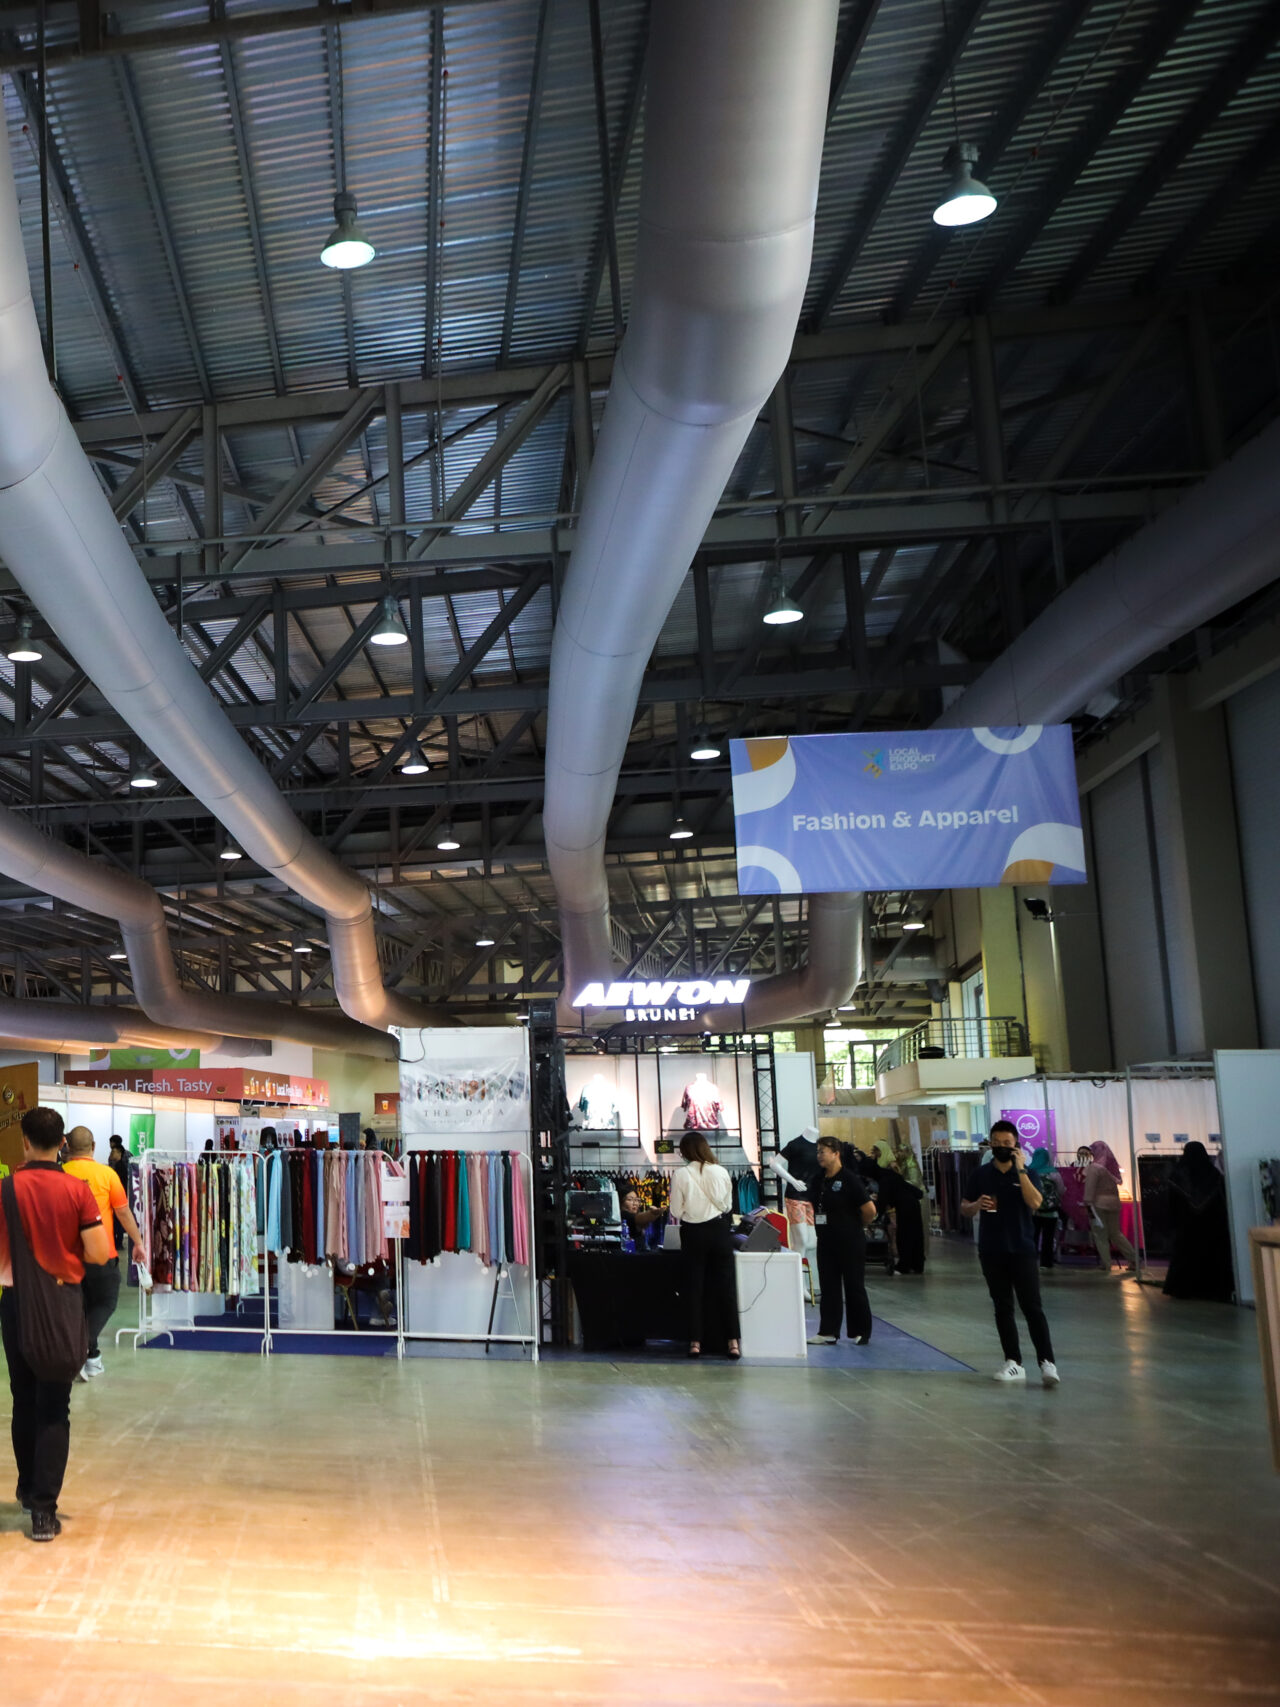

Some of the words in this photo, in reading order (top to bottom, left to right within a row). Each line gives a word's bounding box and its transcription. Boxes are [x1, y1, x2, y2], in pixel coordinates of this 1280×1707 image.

[889, 747, 919, 756] LOCAL
[889, 753, 937, 764] PRODUCT
[889, 762, 918, 771] EXPO
[792, 812, 886, 832] Fashion
[892, 810, 912, 828] &
[918, 805, 1019, 831] Apparel
[626, 1008, 696, 1022] BRUNEI
[135, 1078, 175, 1093] Fresh.
[177, 1078, 213, 1094] Tasty
[424, 1109, 449, 1117] THE
